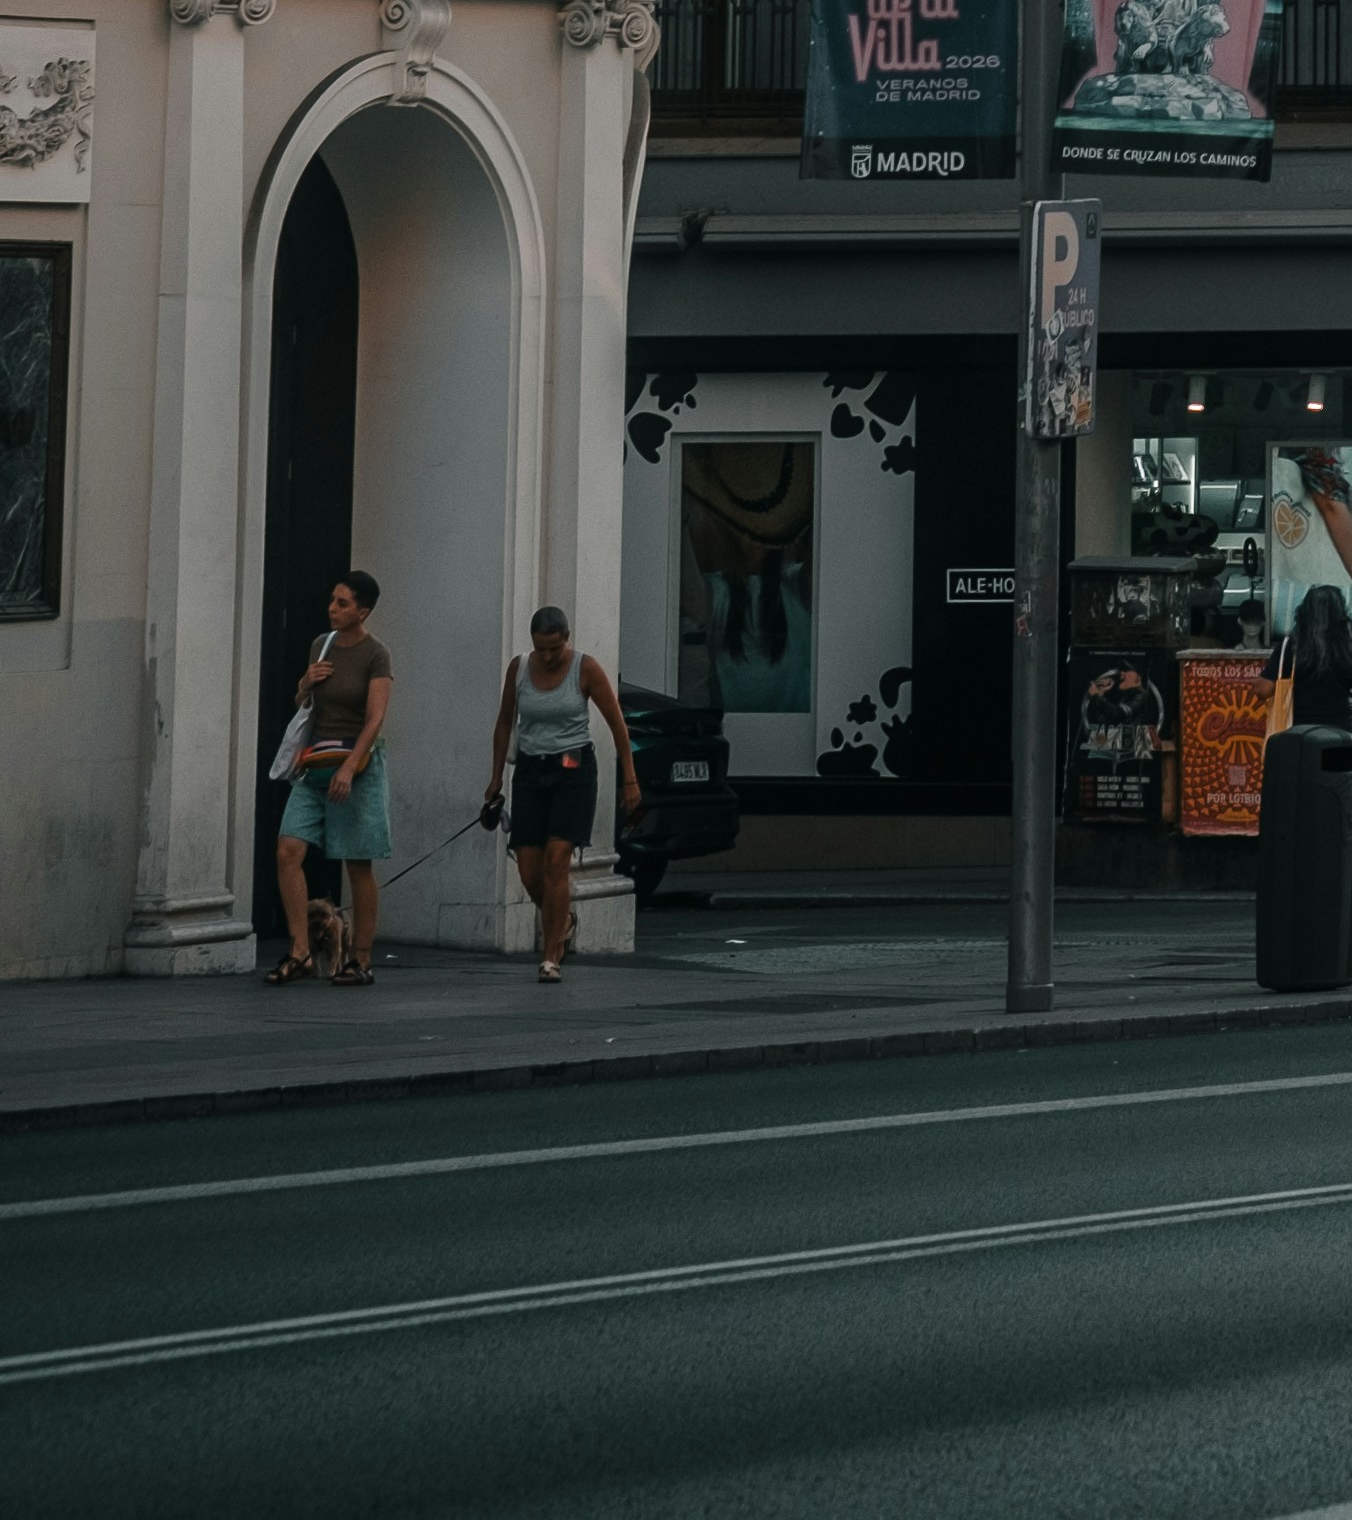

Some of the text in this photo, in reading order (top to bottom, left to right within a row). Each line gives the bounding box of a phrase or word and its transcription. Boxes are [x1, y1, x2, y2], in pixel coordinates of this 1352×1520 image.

[848, 12, 1001, 83] Villa 2026
[876, 78, 969, 89] VERANOS
[875, 89, 981, 102] DE MADRID
[877, 151, 966, 176] MADRID
[1062, 146, 1257, 167] DONDE SE CRUZAN LOS CAMINOS
[1068, 288, 1087, 305] 24 H
[1062, 307, 1095, 328] ÚBLICO
[955, 577, 1015, 594] ALE-HO
